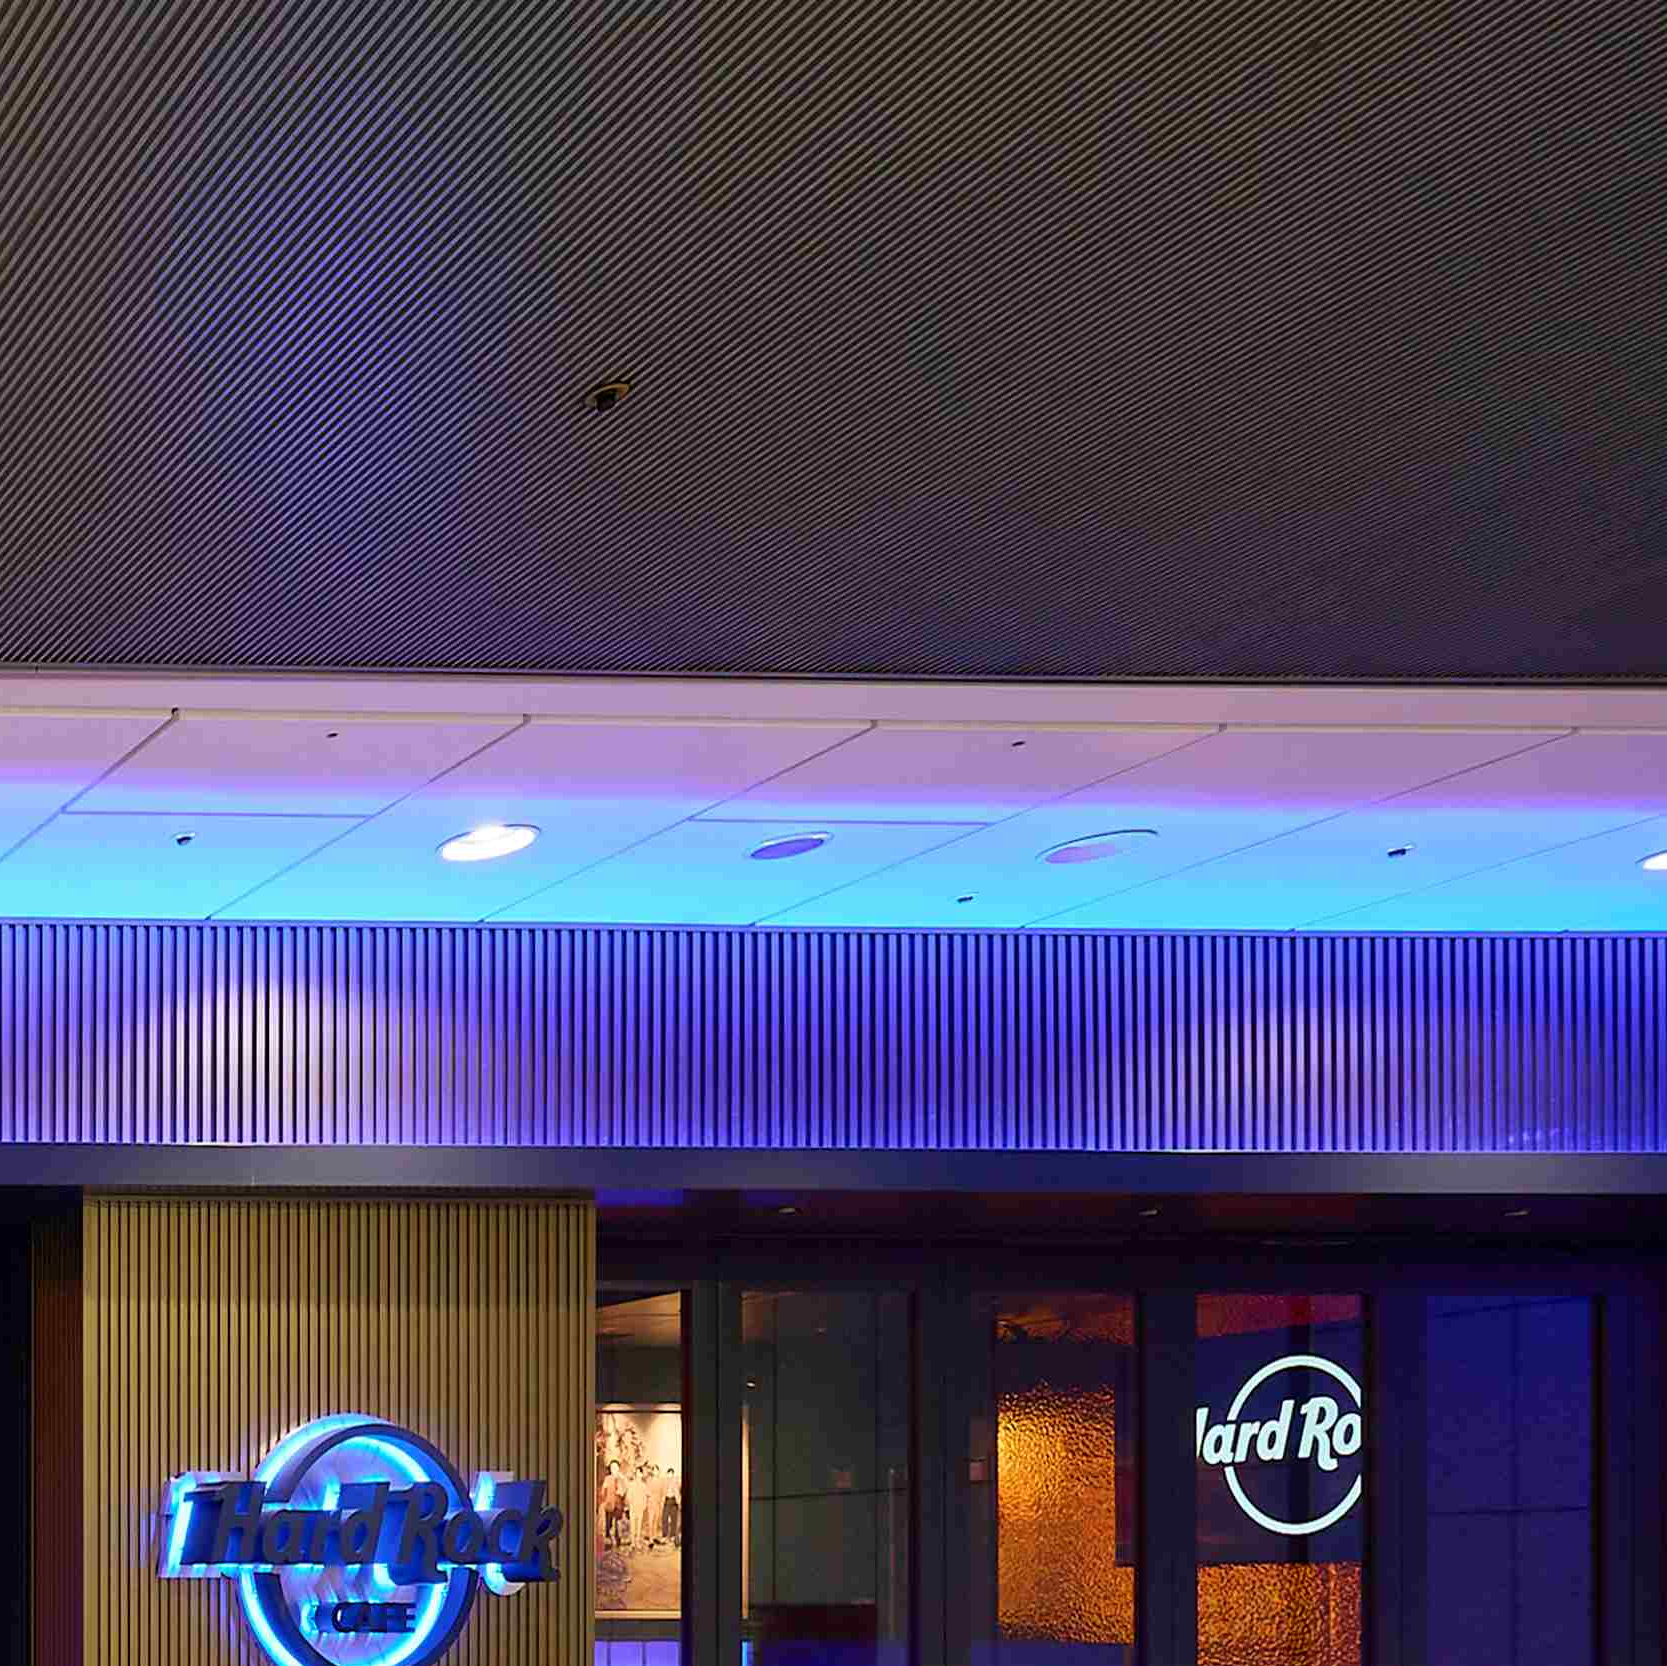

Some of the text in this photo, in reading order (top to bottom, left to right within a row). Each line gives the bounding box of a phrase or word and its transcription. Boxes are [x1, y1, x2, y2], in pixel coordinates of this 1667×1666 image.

[214, 1481, 564, 1583] Hard Rock
[331, 1602, 416, 1632] CAFE
